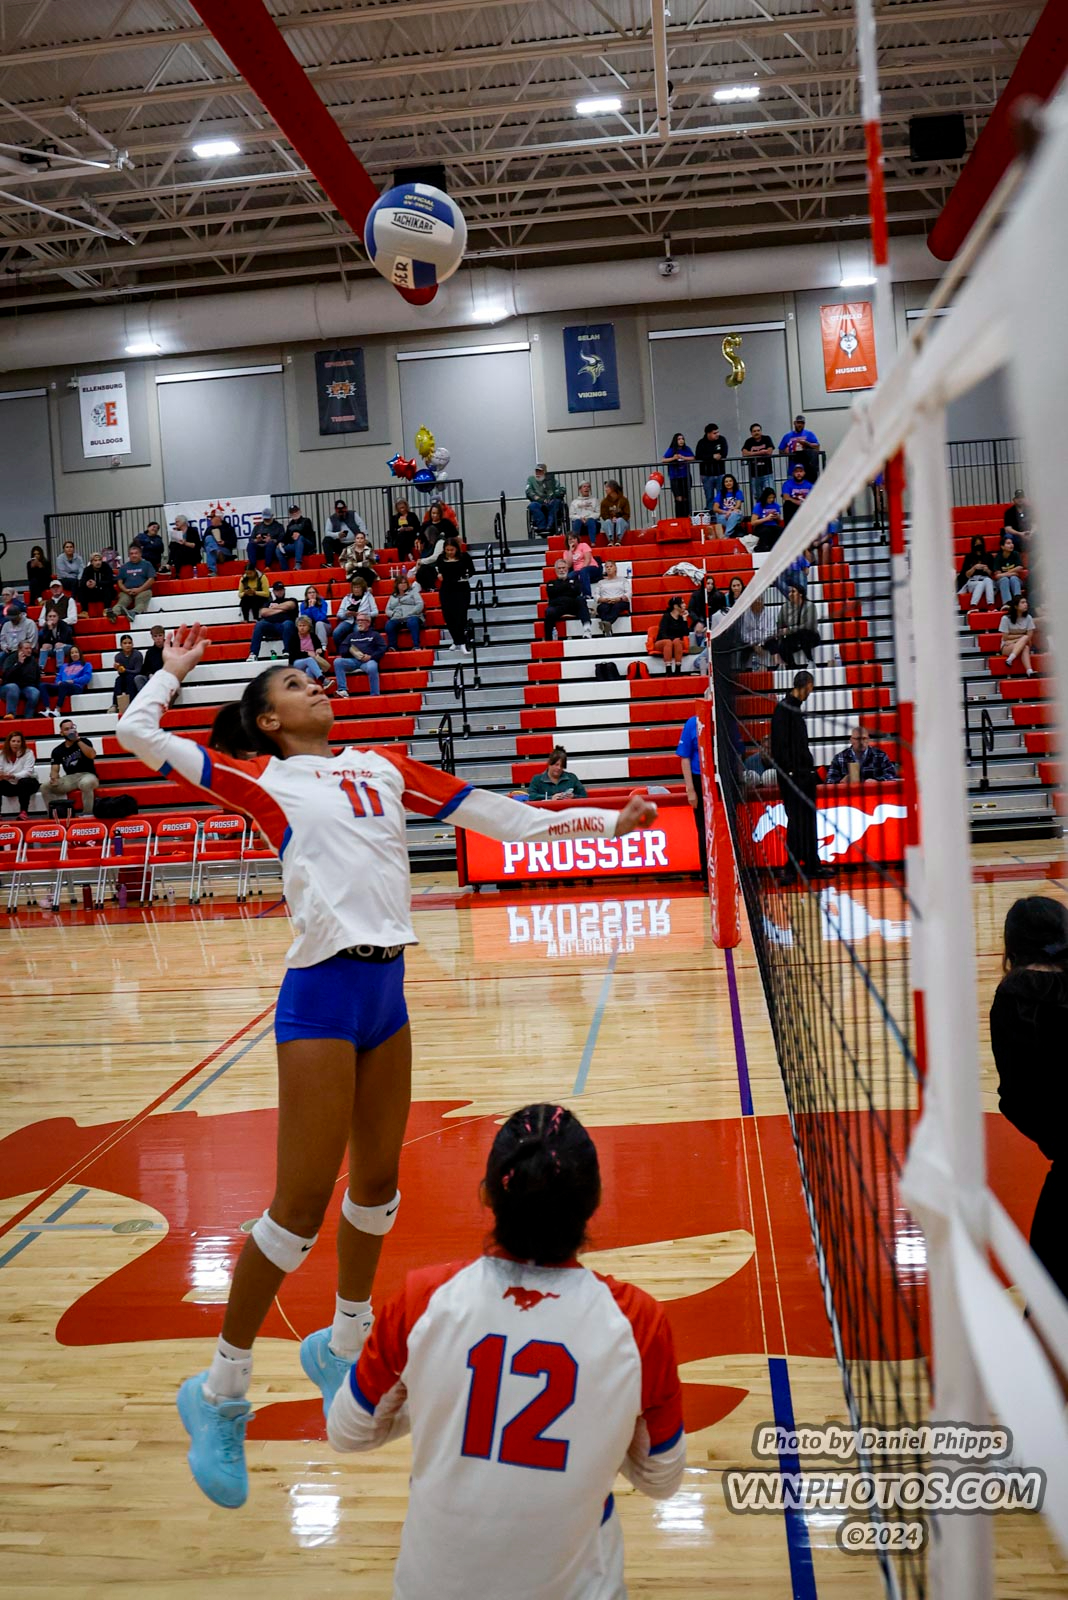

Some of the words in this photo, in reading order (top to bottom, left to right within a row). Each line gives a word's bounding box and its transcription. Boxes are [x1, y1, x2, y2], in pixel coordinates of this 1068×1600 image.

[404, 194, 434, 206] OFFICIAL
[393, 212, 435, 231] TACHIKARA
[577, 333, 601, 342] SELAH
[835, 365, 868, 375] HUSKIES
[82, 382, 123, 393] ELLENSBURG
[577, 390, 608, 399] VIKINGS
[104, 401, 118, 427] E
[90, 437, 124, 446] BULLDOGS
[339, 778, 385, 818] 11
[162, 822, 192, 832] PROSSER
[209, 820, 239, 829] PROSSER
[548, 816, 605, 836] MUSTANGS
[31, 829, 60, 839] PROSSER
[71, 827, 100, 836] PROSSER
[502, 829, 669, 874] PROSSER
[461, 1333, 579, 1472] 12
